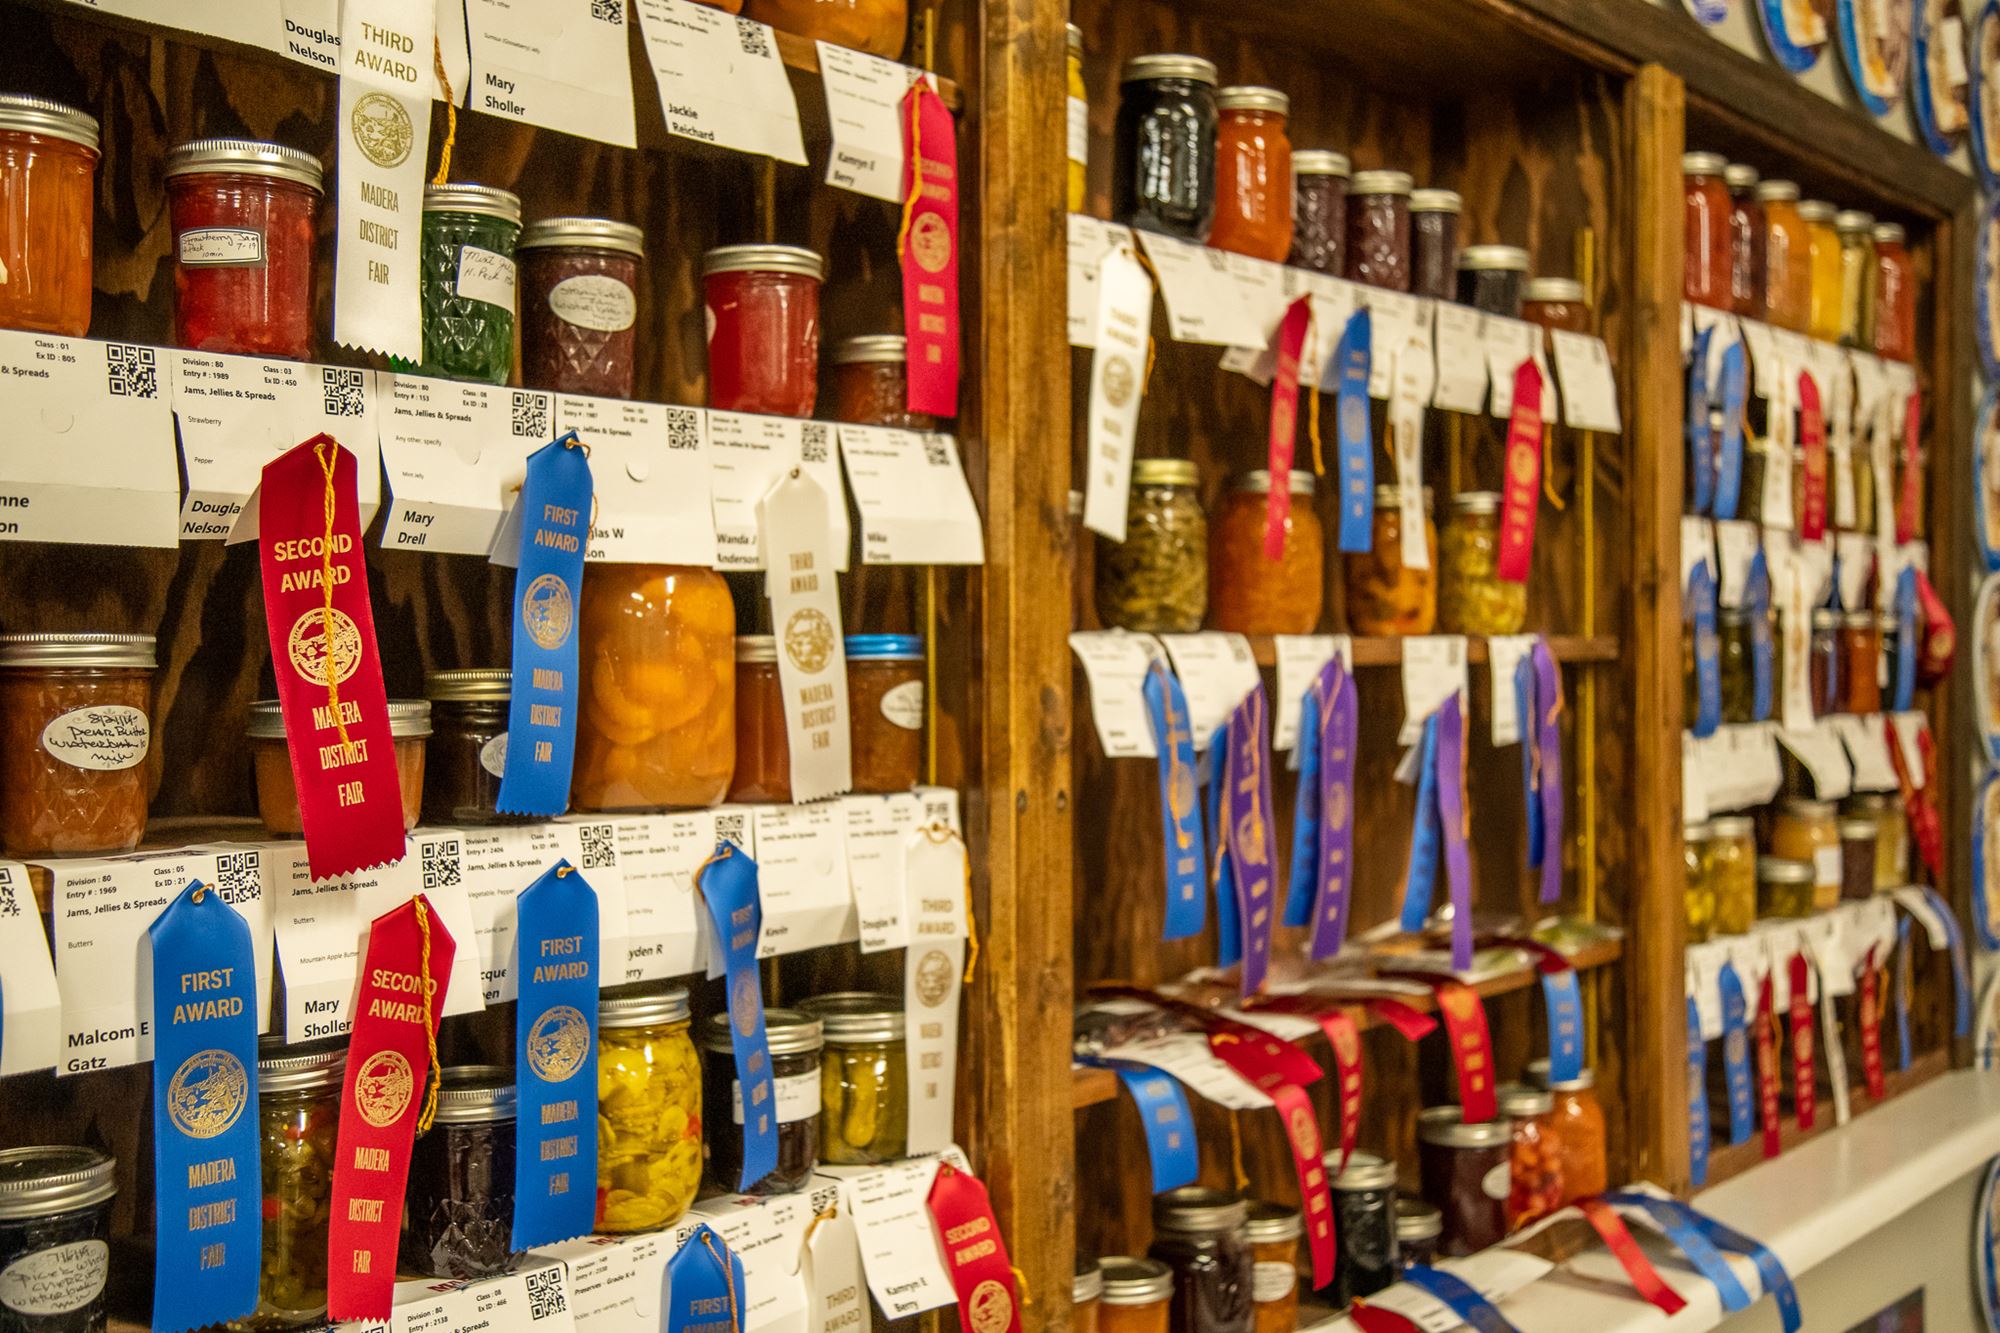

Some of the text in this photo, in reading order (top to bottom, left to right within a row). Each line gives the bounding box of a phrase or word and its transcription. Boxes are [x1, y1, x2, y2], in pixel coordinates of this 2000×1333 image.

[284, 19, 341, 46] Douglas
[361, 21, 414, 54] THIRD
[288, 41, 336, 66] Nelson
[354, 49, 418, 83] AWARD
[485, 73, 515, 94] Mary
[485, 96, 525, 116] Sholler
[361, 181, 399, 213] MADERA
[359, 219, 399, 250] DISTRICT
[368, 260, 389, 285] FAIR
[35, 340, 54, 350] Class
[36, 352, 45, 360] Ex
[183, 358, 210, 367] Division
[1, 366, 50, 378] & Spreads
[183, 370, 201, 379] Entry
[263, 366, 279, 374] Class
[184, 386, 276, 401] Jams, Jellies & Spreads
[188, 415, 222, 427] Strawberry
[194, 456, 214, 465] Pepper
[191, 500, 242, 517] Dougla
[403, 510, 435, 527] Mary
[544, 504, 580, 527] FIRST
[183, 522, 230, 535] Nelson
[398, 532, 427, 545] Drell
[274, 533, 353, 562] SECOND
[534, 528, 580, 552] AWARD
[280, 565, 351, 593] AWARD
[338, 780, 365, 807] FAIR
[153, 868, 171, 876] Class
[292, 872, 309, 880] Entry
[66, 878, 97, 887] Division
[155, 880, 163, 888] Ex
[164, 879, 173, 887] ID
[292, 880, 378, 897] Jams, Jellies & Spreads
[66, 886, 117, 900] Entry 1969
[66, 897, 168, 918] Jams, Jellies & Spreads
[293, 917, 315, 925] Butters
[68, 939, 93, 949] Butters
[541, 936, 584, 957] FIRST
[181, 967, 234, 994] FIRST
[533, 961, 589, 984] AWARD
[173, 997, 244, 1025] AWARD
[304, 999, 339, 1015] Mary
[68, 1021, 150, 1048] Malcom E
[304, 1020, 352, 1038] Sholler
[67, 1056, 108, 1073] Gatz
[354, 1146, 390, 1172] MADERA
[188, 1157, 236, 1189] MADERA
[188, 1198, 238, 1232] DISTRICT
[348, 1198, 385, 1223] DISTRICT
[200, 1243, 226, 1270] FAIR
[353, 1250, 371, 1273] FAIR
[407, 1311, 431, 1322] Division
